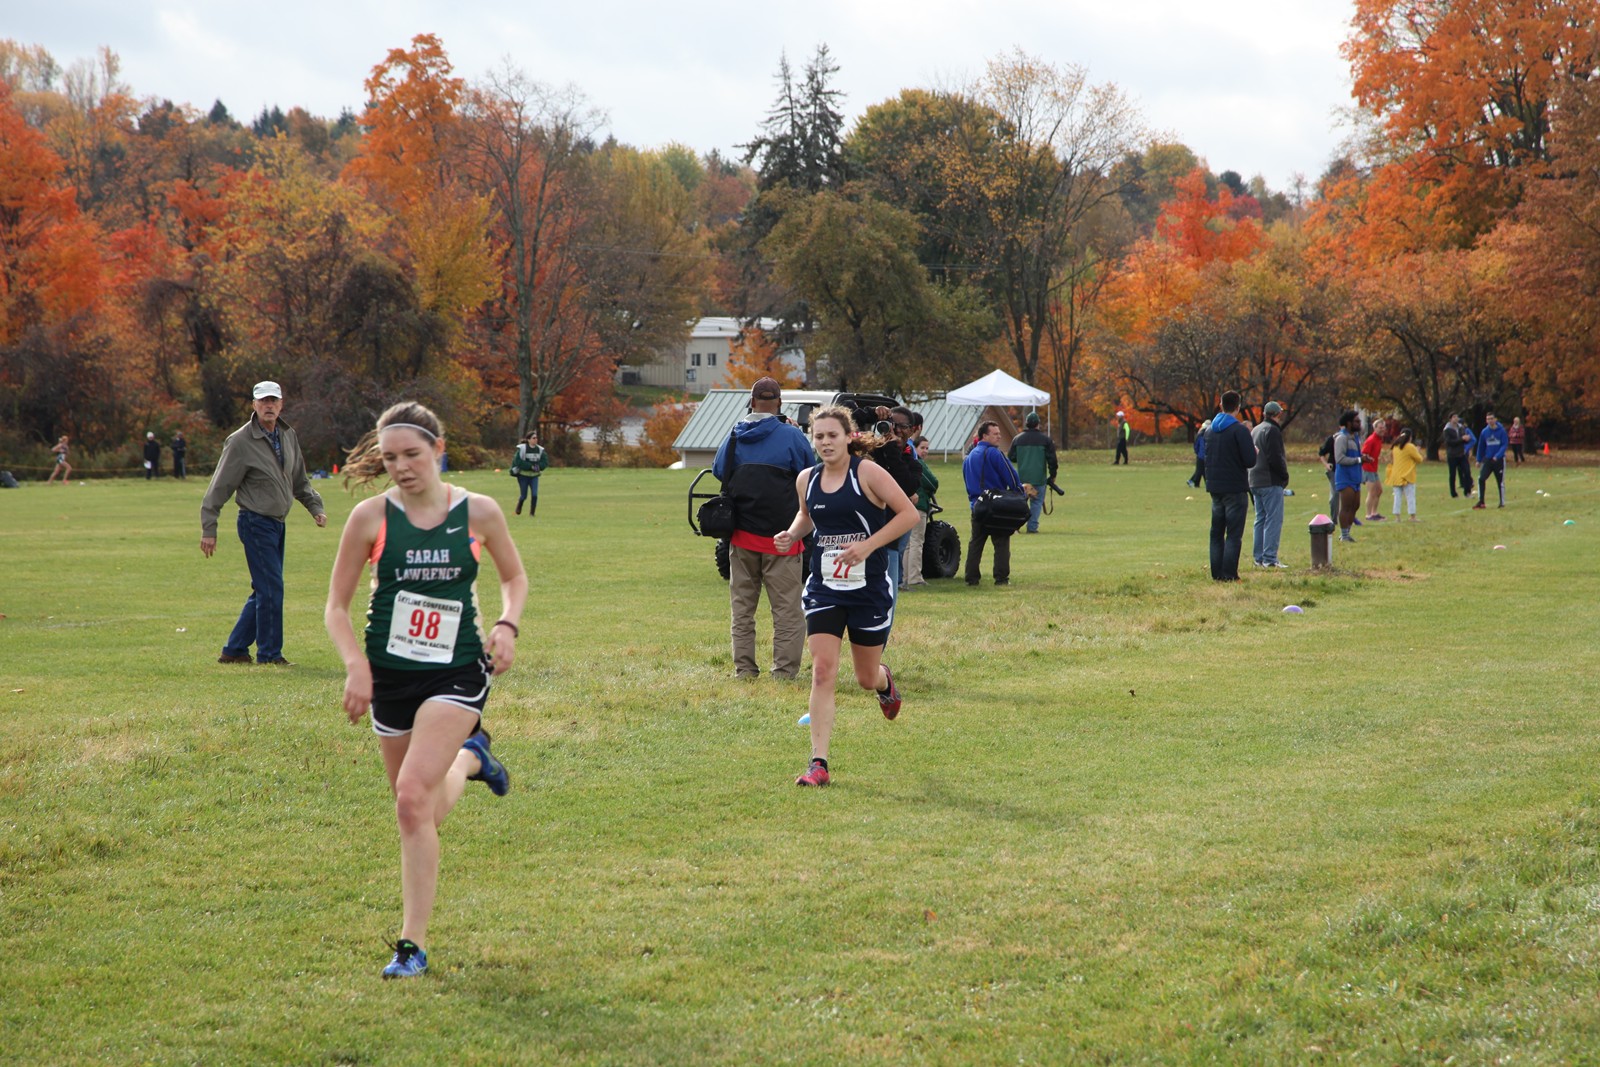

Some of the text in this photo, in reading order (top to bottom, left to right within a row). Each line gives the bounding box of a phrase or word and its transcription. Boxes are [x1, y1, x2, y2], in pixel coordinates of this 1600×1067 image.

[817, 532, 867, 546] MARITIME
[406, 549, 450, 563] SARAH
[394, 567, 462, 581] LAWRENCE
[398, 595, 460, 612] SKYLINE CONFERENCE
[408, 609, 441, 640] 98
